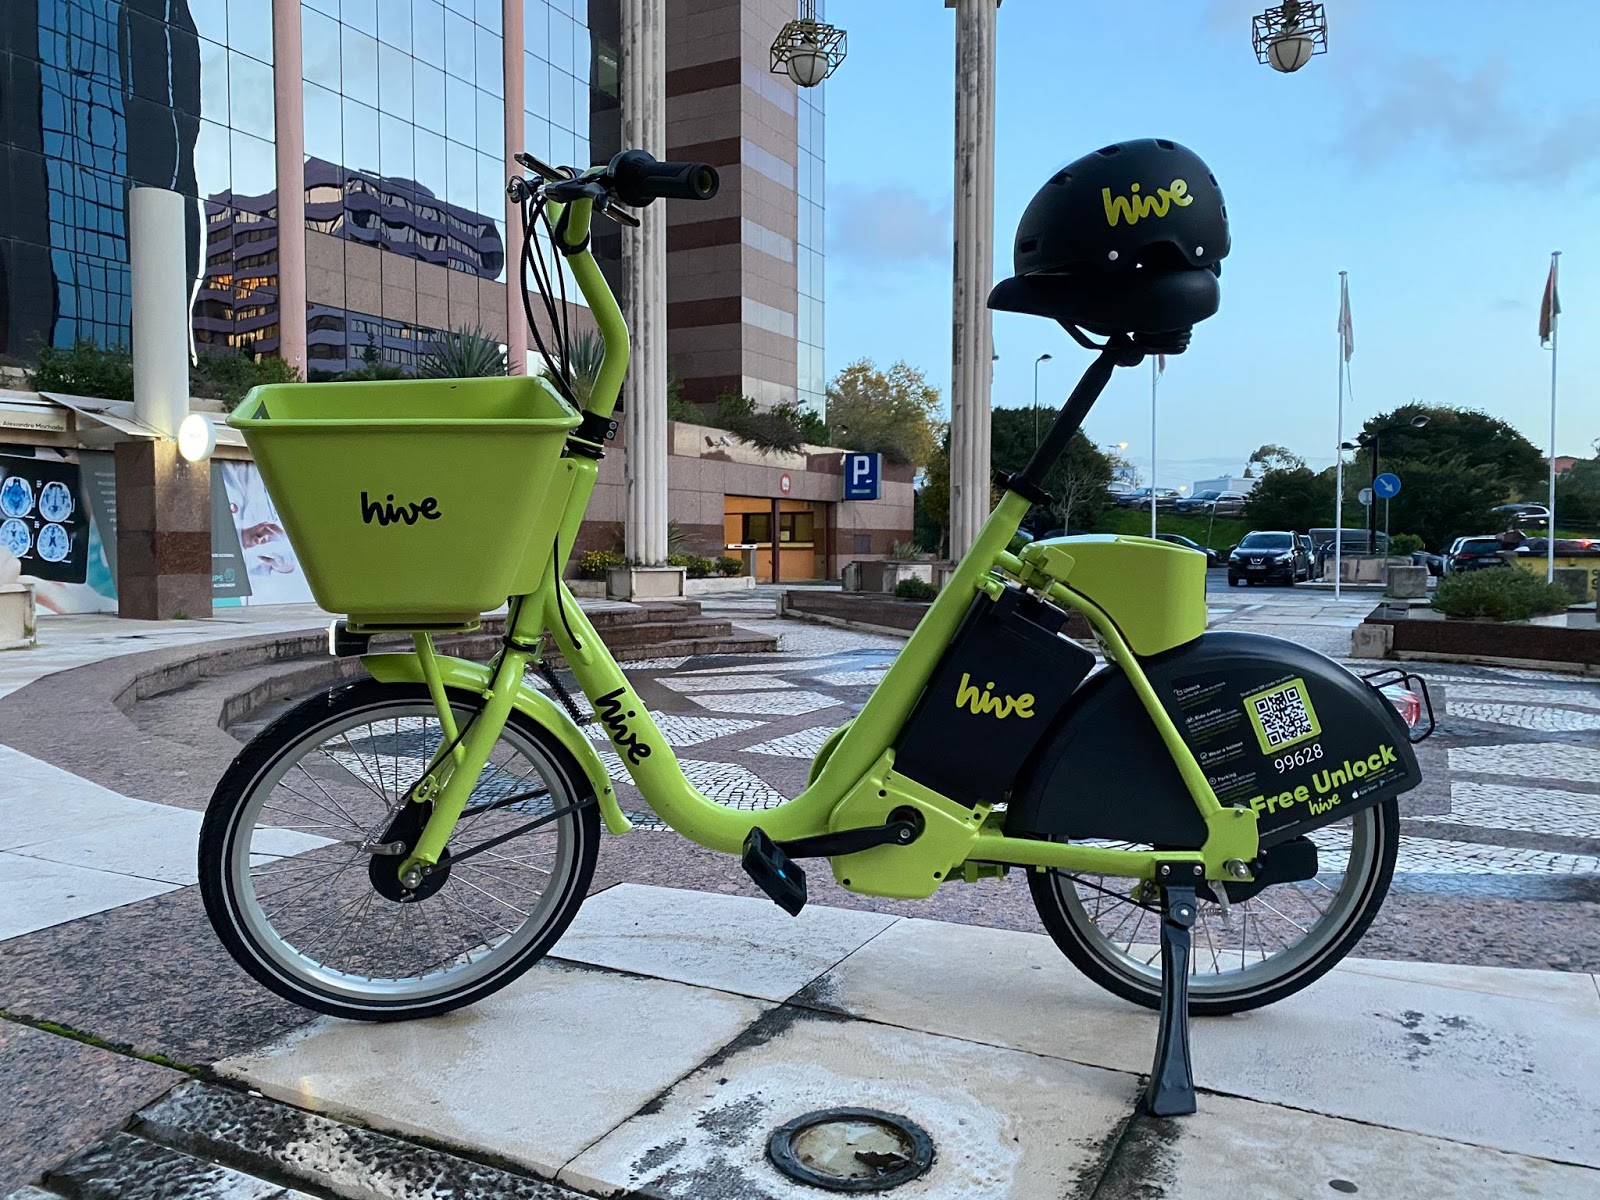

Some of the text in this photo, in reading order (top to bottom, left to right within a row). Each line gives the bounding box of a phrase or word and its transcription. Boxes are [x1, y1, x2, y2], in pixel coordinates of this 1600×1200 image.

[1102, 179, 1194, 227] hive
[853, 455, 870, 485] P
[360, 491, 442, 526] hive
[955, 672, 1035, 719] hive
[594, 686, 652, 766] hive
[1274, 743, 1324, 774] 99628
[1250, 785, 1309, 819] Free
[1312, 744, 1397, 793] Unlock
[1308, 793, 1341, 815] hive
